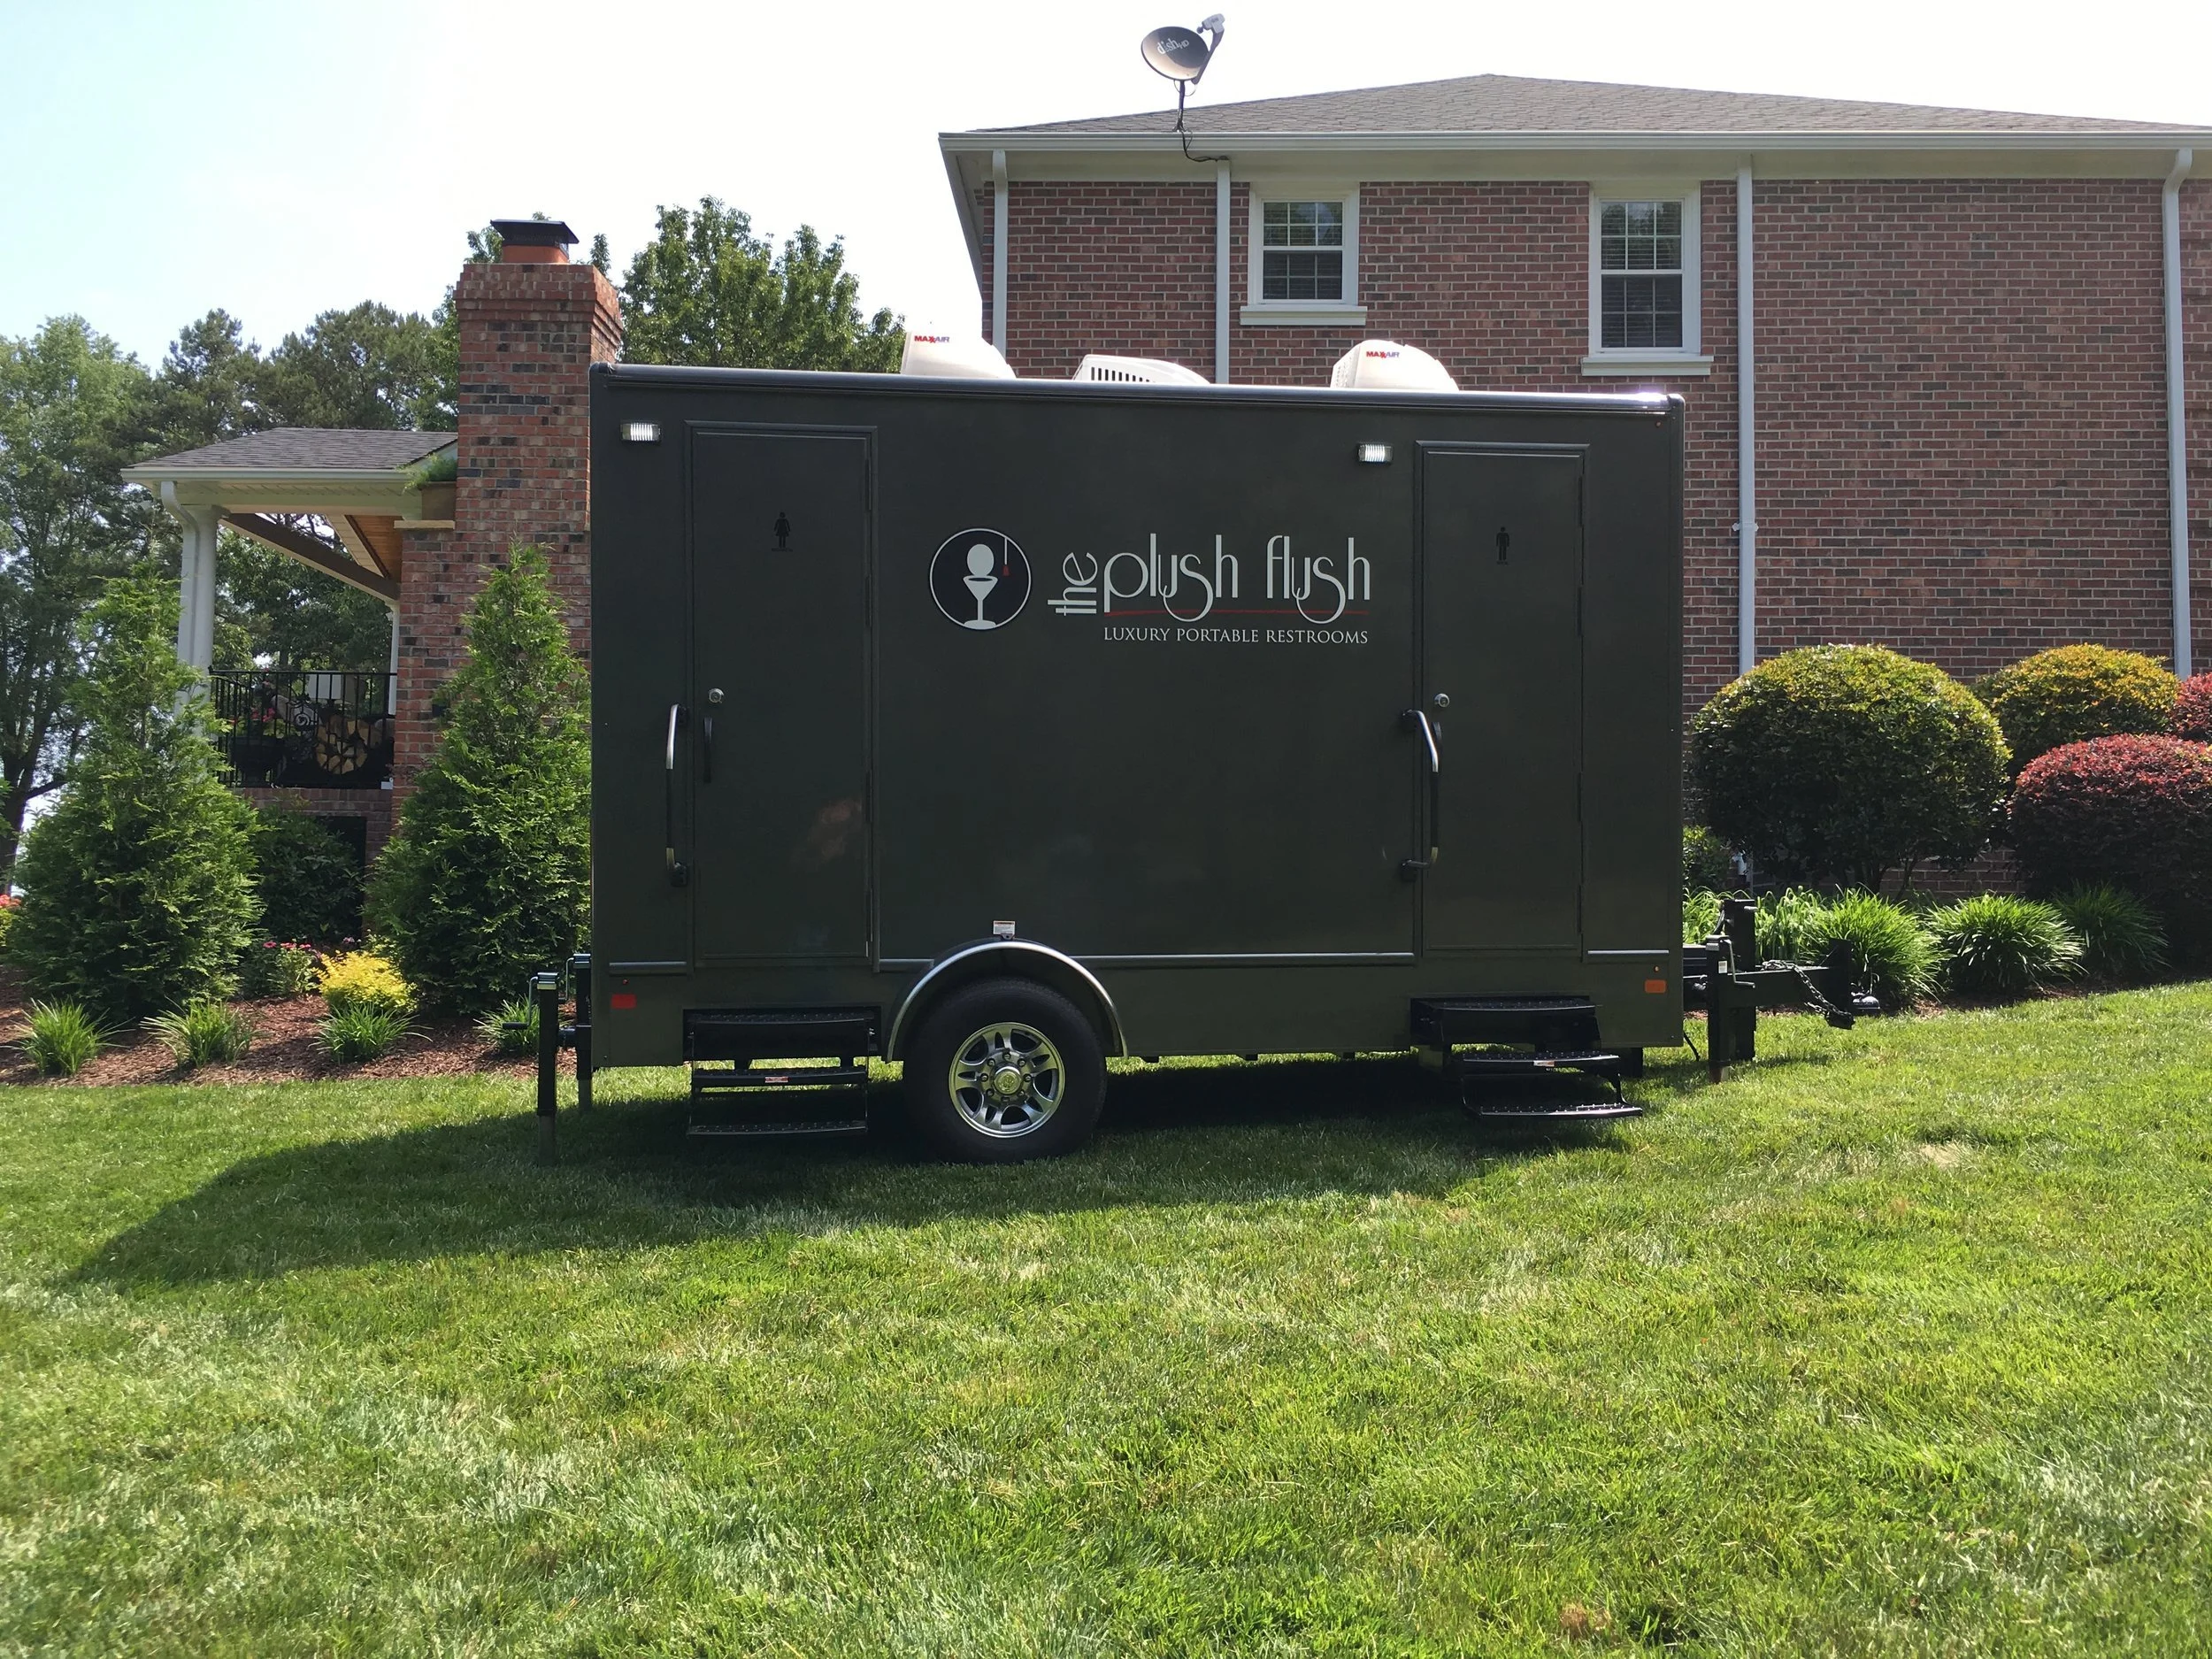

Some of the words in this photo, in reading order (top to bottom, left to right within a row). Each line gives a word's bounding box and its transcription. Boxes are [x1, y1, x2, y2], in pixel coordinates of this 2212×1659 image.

[1156, 37, 1178, 54] dish
[1048, 552, 1097, 616] the
[1104, 534, 1238, 622] plush
[1267, 535, 1370, 624] flush
[1105, 627, 1170, 641] LUXURY
[1178, 628, 1258, 642] PORTABLE
[1267, 630, 1367, 643] RESTROOMS
